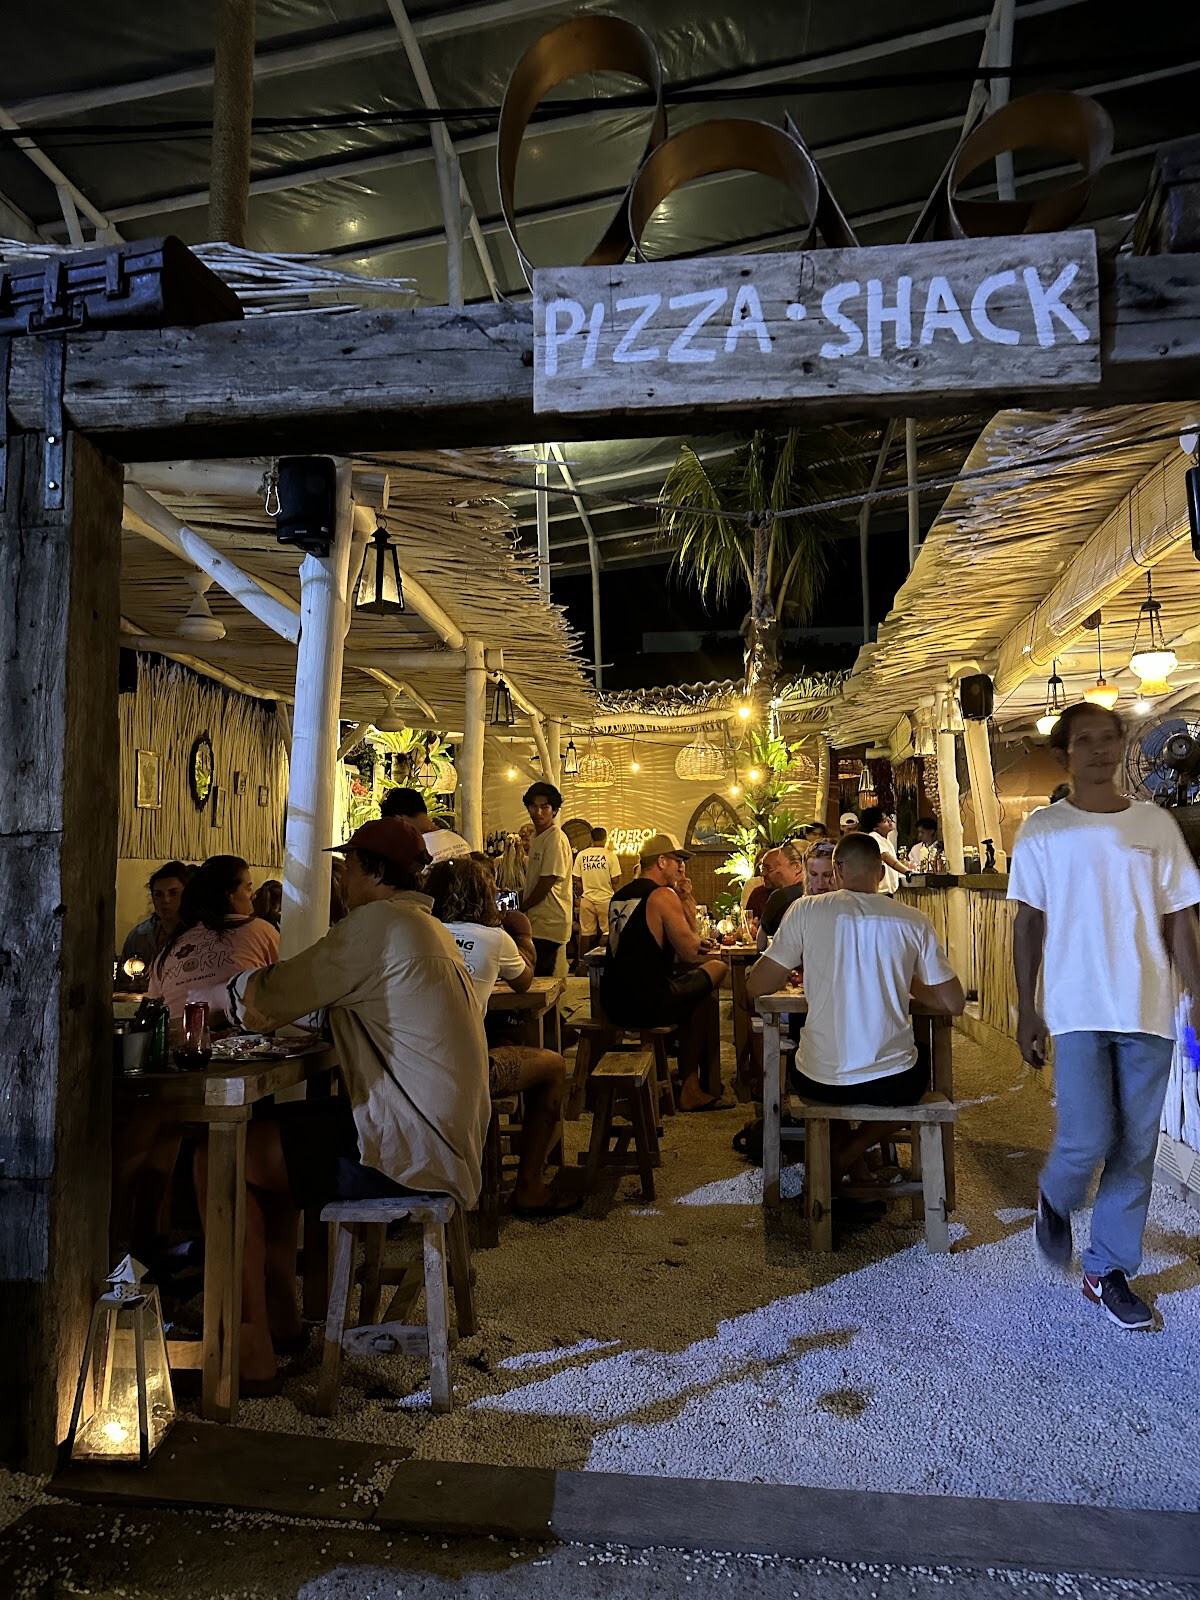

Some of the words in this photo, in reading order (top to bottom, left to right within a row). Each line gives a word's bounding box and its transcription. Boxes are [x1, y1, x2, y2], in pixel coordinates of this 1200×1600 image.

[544, 285, 773, 377] PIZZA
[820, 262, 1091, 358] SHACK
[582, 855, 607, 863] PIZZA
[582, 862, 607, 871] SHACK
[165, 950, 235, 980] WORK
